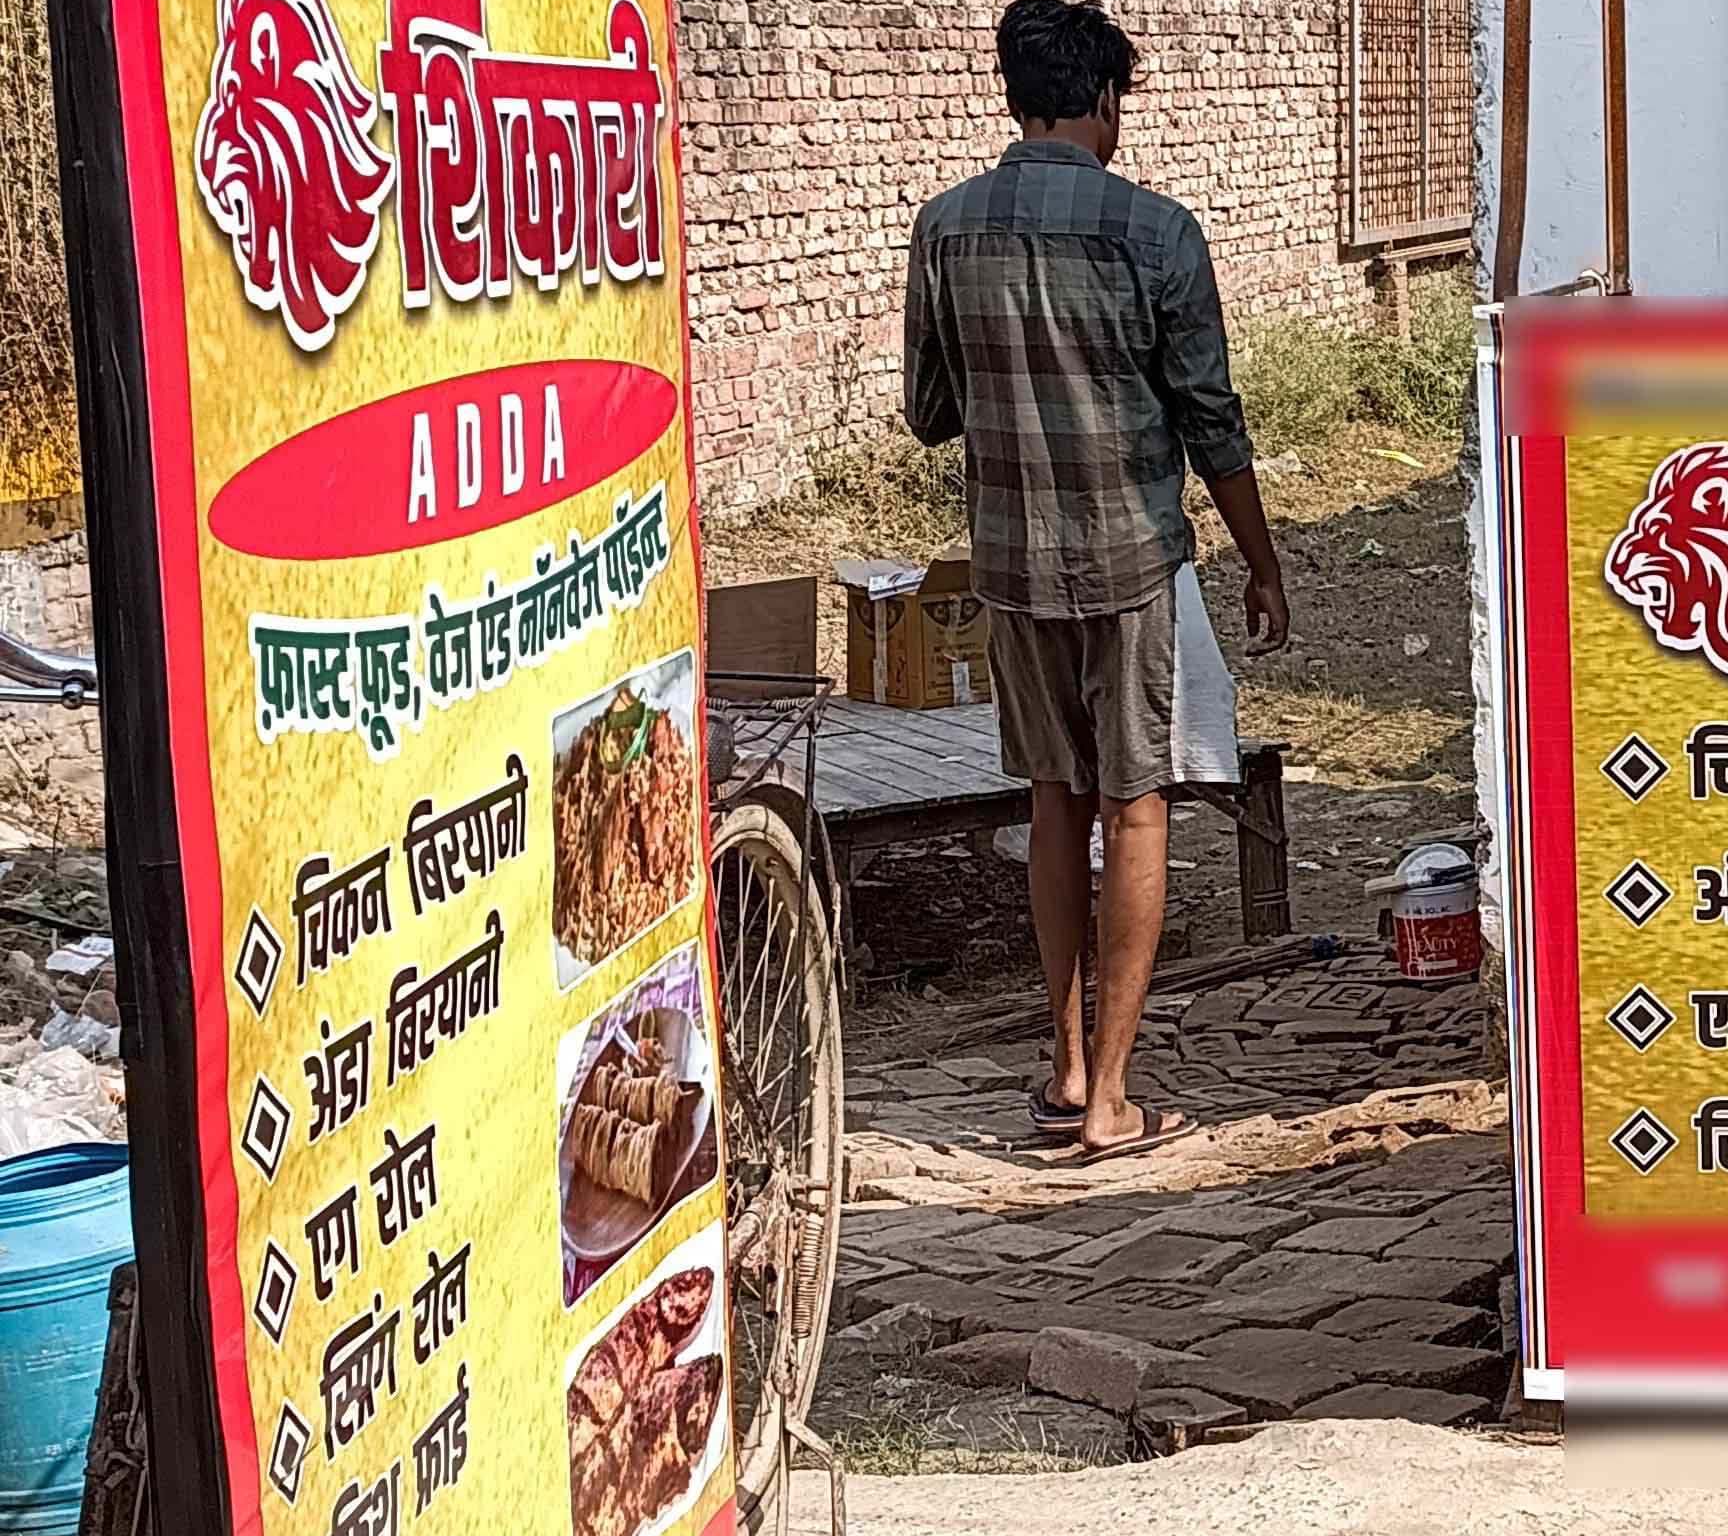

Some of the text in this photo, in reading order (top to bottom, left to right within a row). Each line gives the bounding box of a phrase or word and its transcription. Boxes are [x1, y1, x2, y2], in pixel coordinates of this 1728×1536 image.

[407, 384, 566, 524] ADDA
[425, 593, 472, 697] वेज
[477, 580, 513, 681] एंड
[516, 538, 604, 657] नॉनवेज
[291, 752, 530, 990] चिकन बिरयानी
[302, 909, 505, 1144] अंडा बिरयानी
[304, 1123, 438, 1303] एग रोल
[411, 1242, 473, 1363] रोल
[412, 1362, 471, 1522] फ्राई
